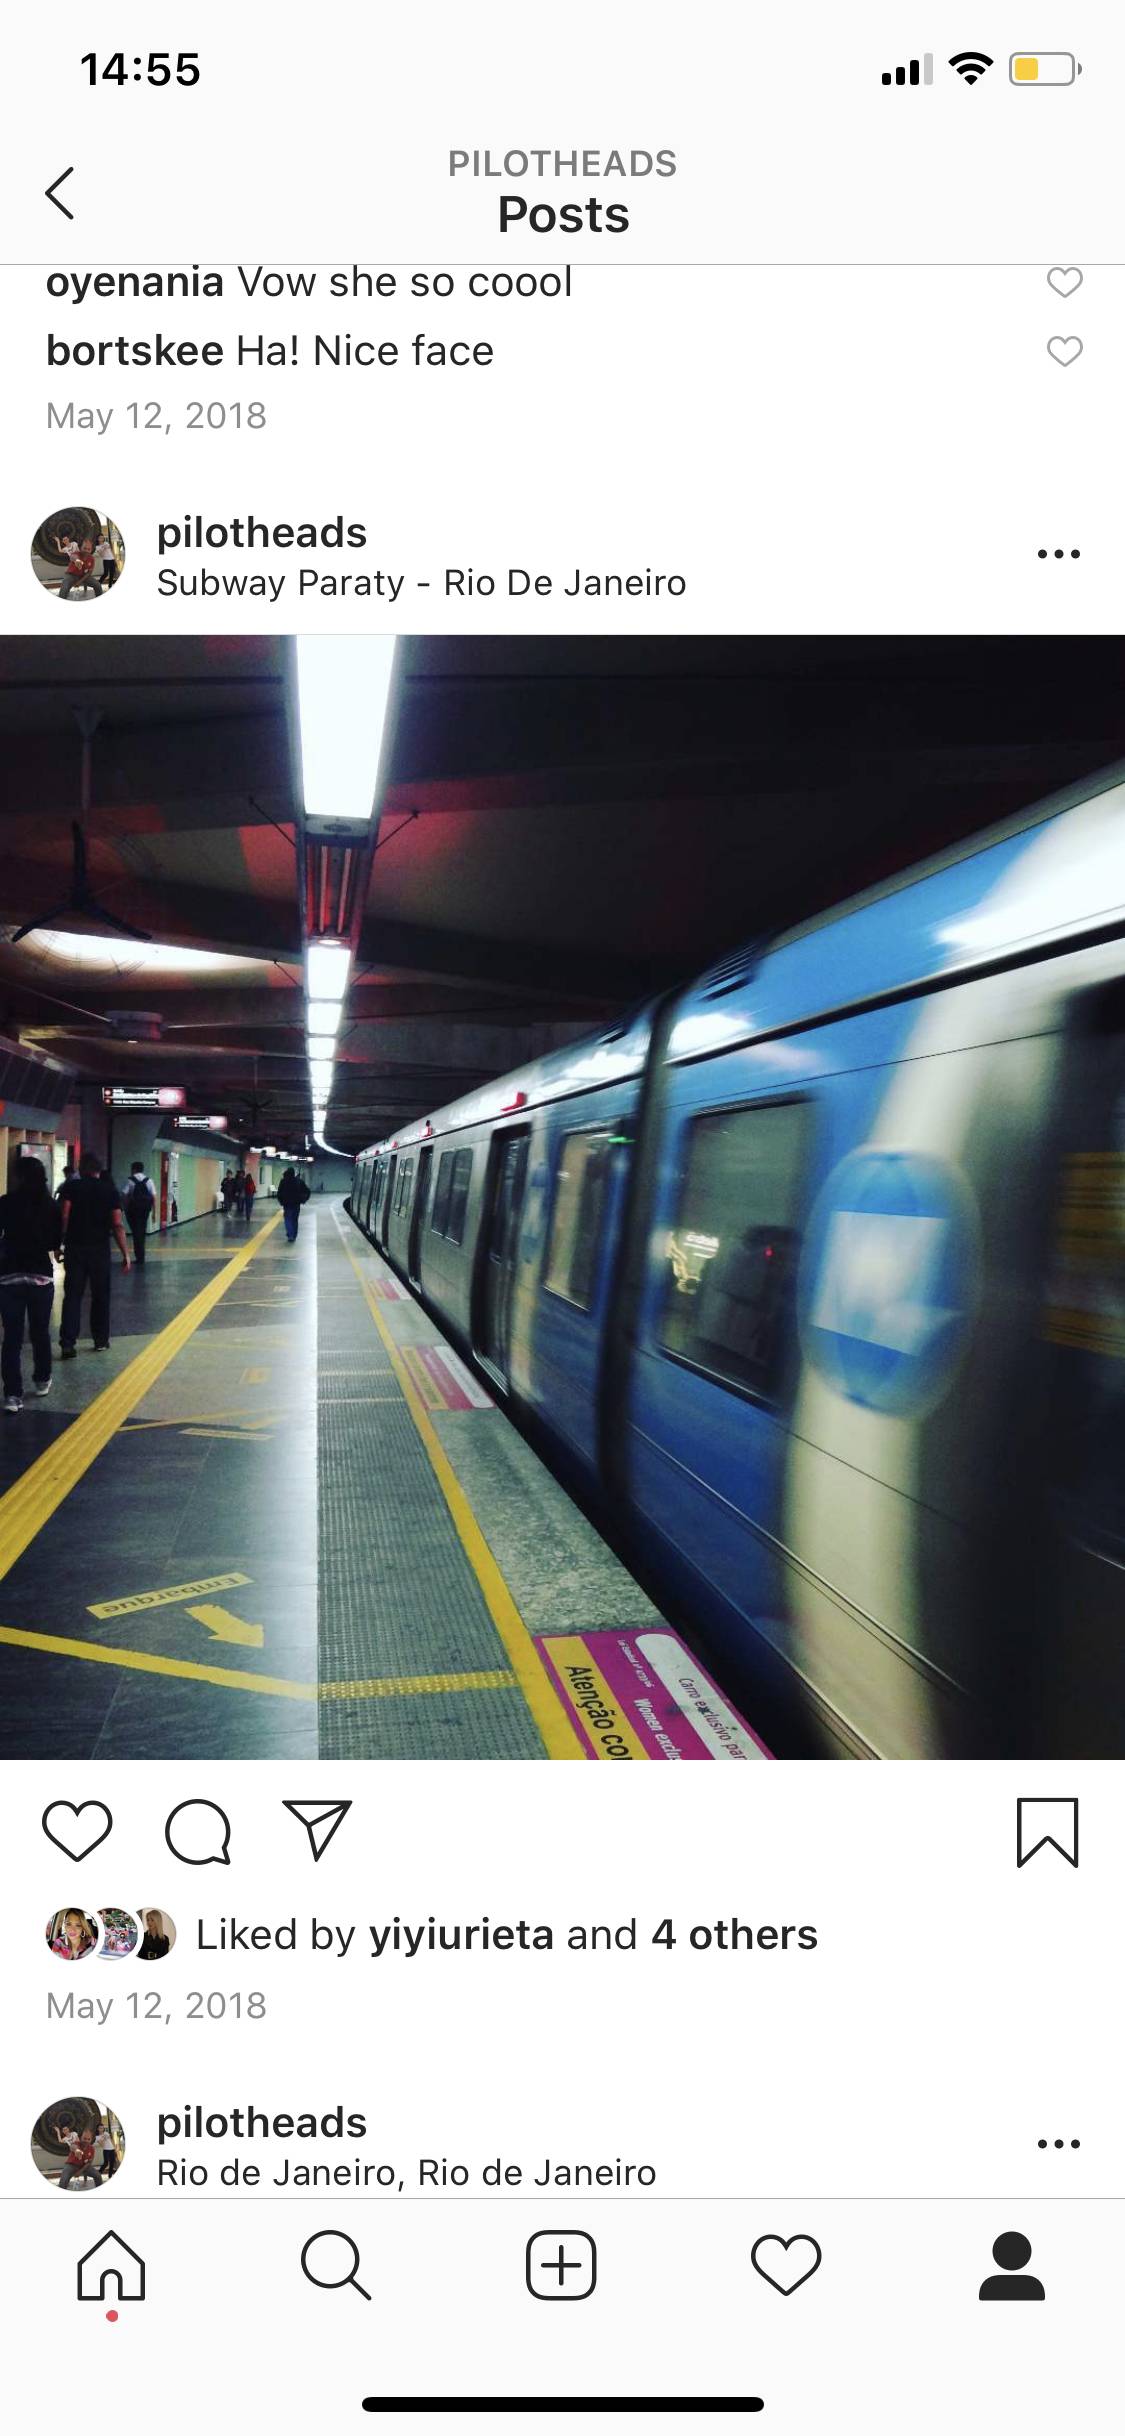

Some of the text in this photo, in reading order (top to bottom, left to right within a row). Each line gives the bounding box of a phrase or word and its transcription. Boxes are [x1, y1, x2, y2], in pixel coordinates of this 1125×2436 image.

[81, 53, 201, 87] 14:55
[449, 149, 677, 178] PILOTHEADS
[499, 196, 630, 234] Posts
[47, 265, 571, 305] oyenania Vow she so coool
[48, 334, 494, 366] bortskee Ha! Nice face
[47, 402, 267, 435] May 12, 2018
[158, 515, 367, 555] pilotheads
[157, 568, 286, 603] Subway
[299, 568, 404, 603] Paraty
[446, 568, 496, 597] Rio
[509, 568, 553, 597] De
[564, 568, 687, 597] Janeiro
[104, 1577, 241, 1613] Embarque
[564, 1666, 617, 1730] Atenção
[633, 1698, 663, 1732] Women
[678, 1678, 701, 1699] Carro
[695, 1701, 733, 1741] exclusivo
[197, 1917, 818, 1958] Liked by yiyiurieta and 4 others
[47, 1991, 266, 2025] May 12, 2018
[158, 2105, 367, 2145] pilotheads
[158, 2157, 657, 2193] Rio de Janeiro, Rio de Janeiro
